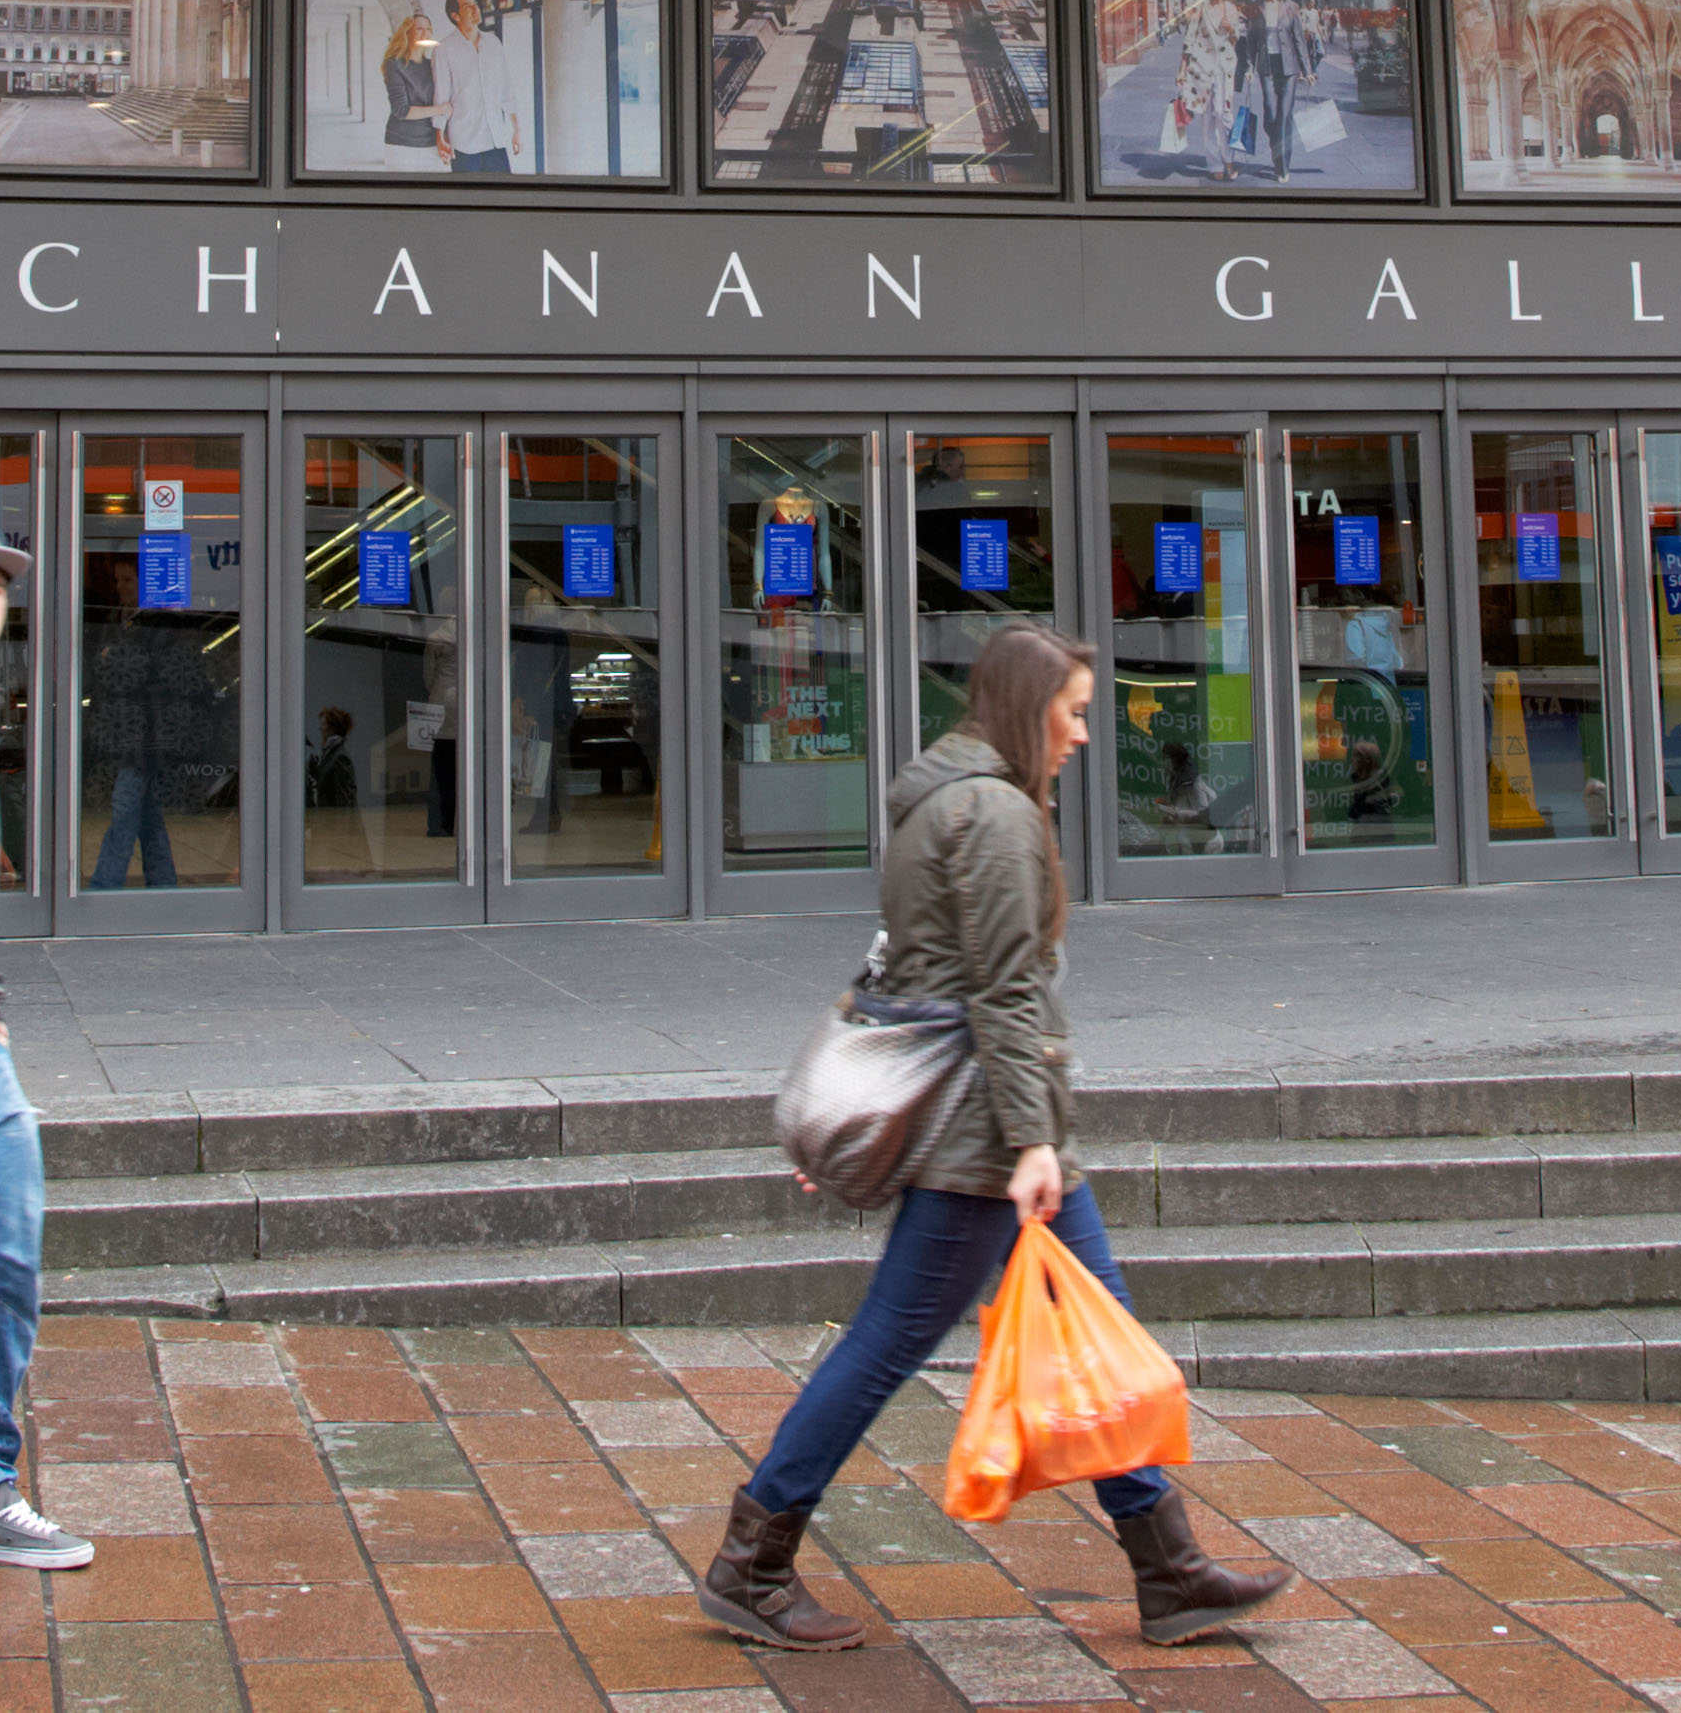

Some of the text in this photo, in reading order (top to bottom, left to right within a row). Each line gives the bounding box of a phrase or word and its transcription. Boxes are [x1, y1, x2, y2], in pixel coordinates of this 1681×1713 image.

[786, 686, 828, 702] THE
[787, 702, 844, 718] NEXT
[789, 733, 852, 751] THING
